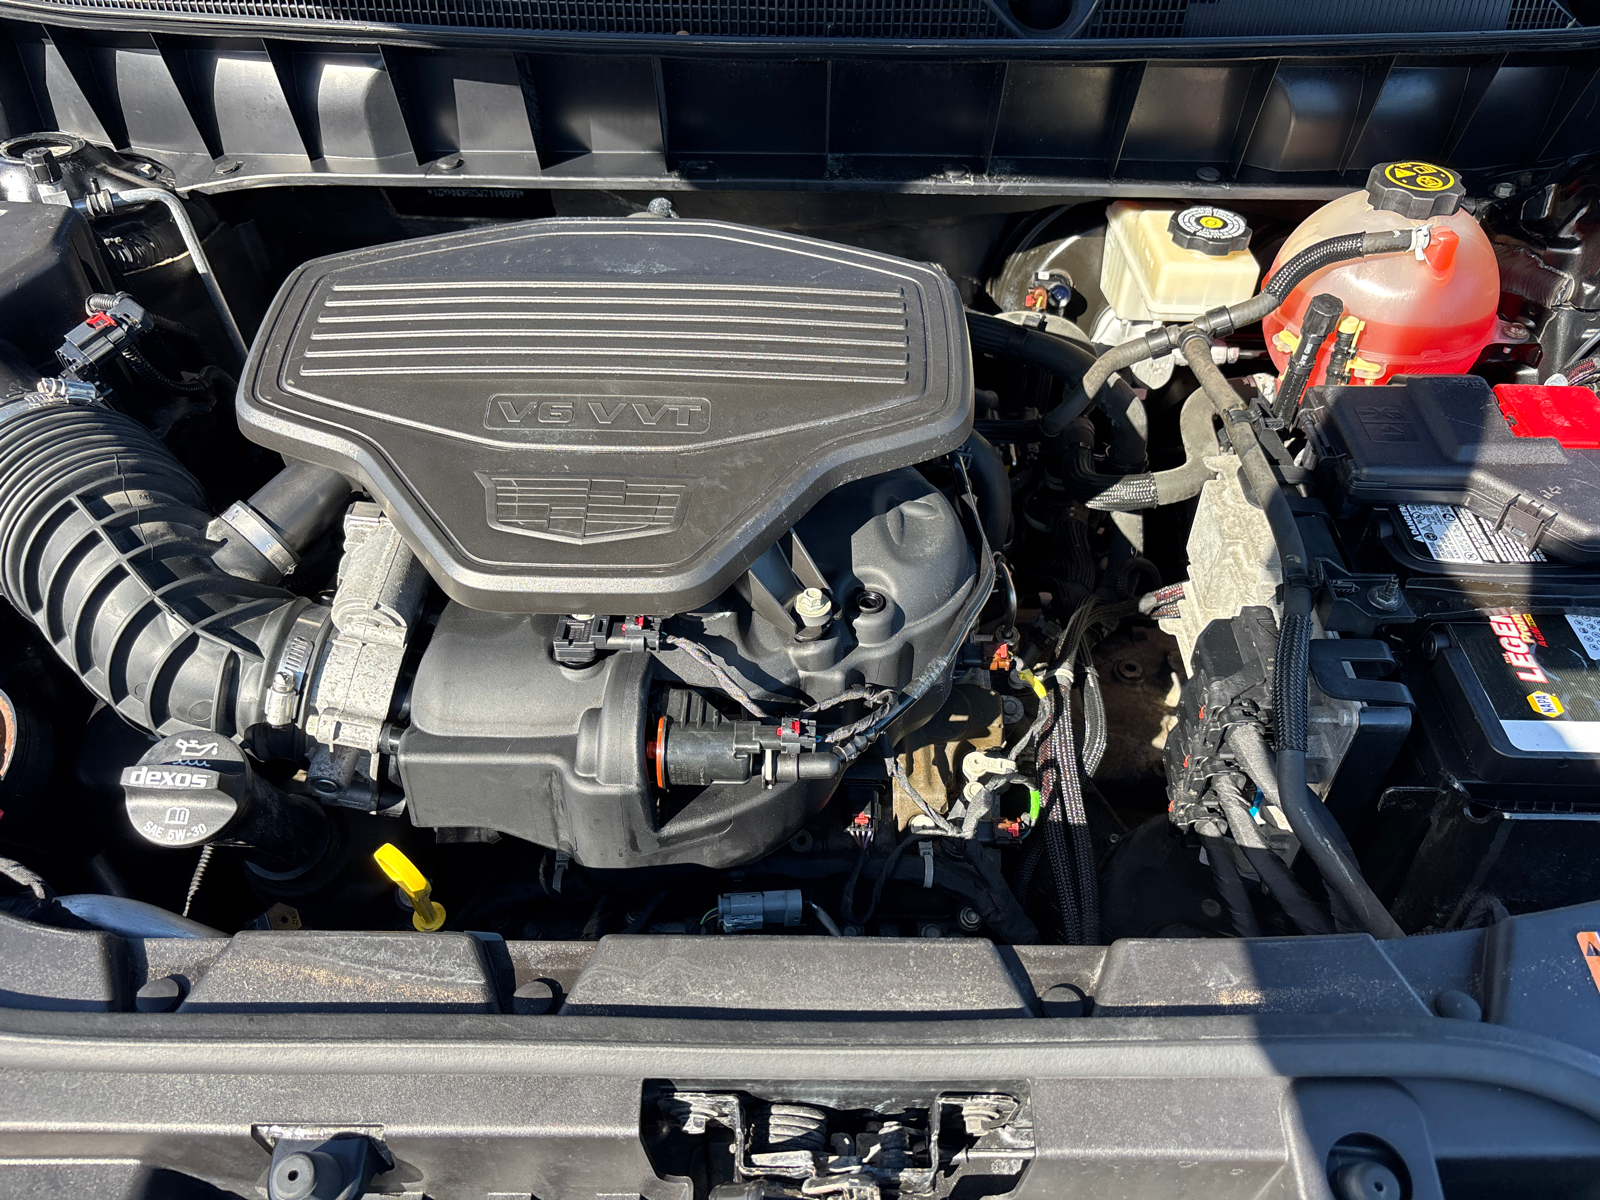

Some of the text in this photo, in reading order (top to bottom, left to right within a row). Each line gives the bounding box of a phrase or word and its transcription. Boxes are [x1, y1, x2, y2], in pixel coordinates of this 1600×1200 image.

[497, 401, 702, 426] V6 VVT
[1530, 627, 1549, 648] AGM
[1535, 695, 1557, 714] NAPA
[129, 766, 208, 788] dexos
[143, 821, 207, 841] SAE 5W-30
